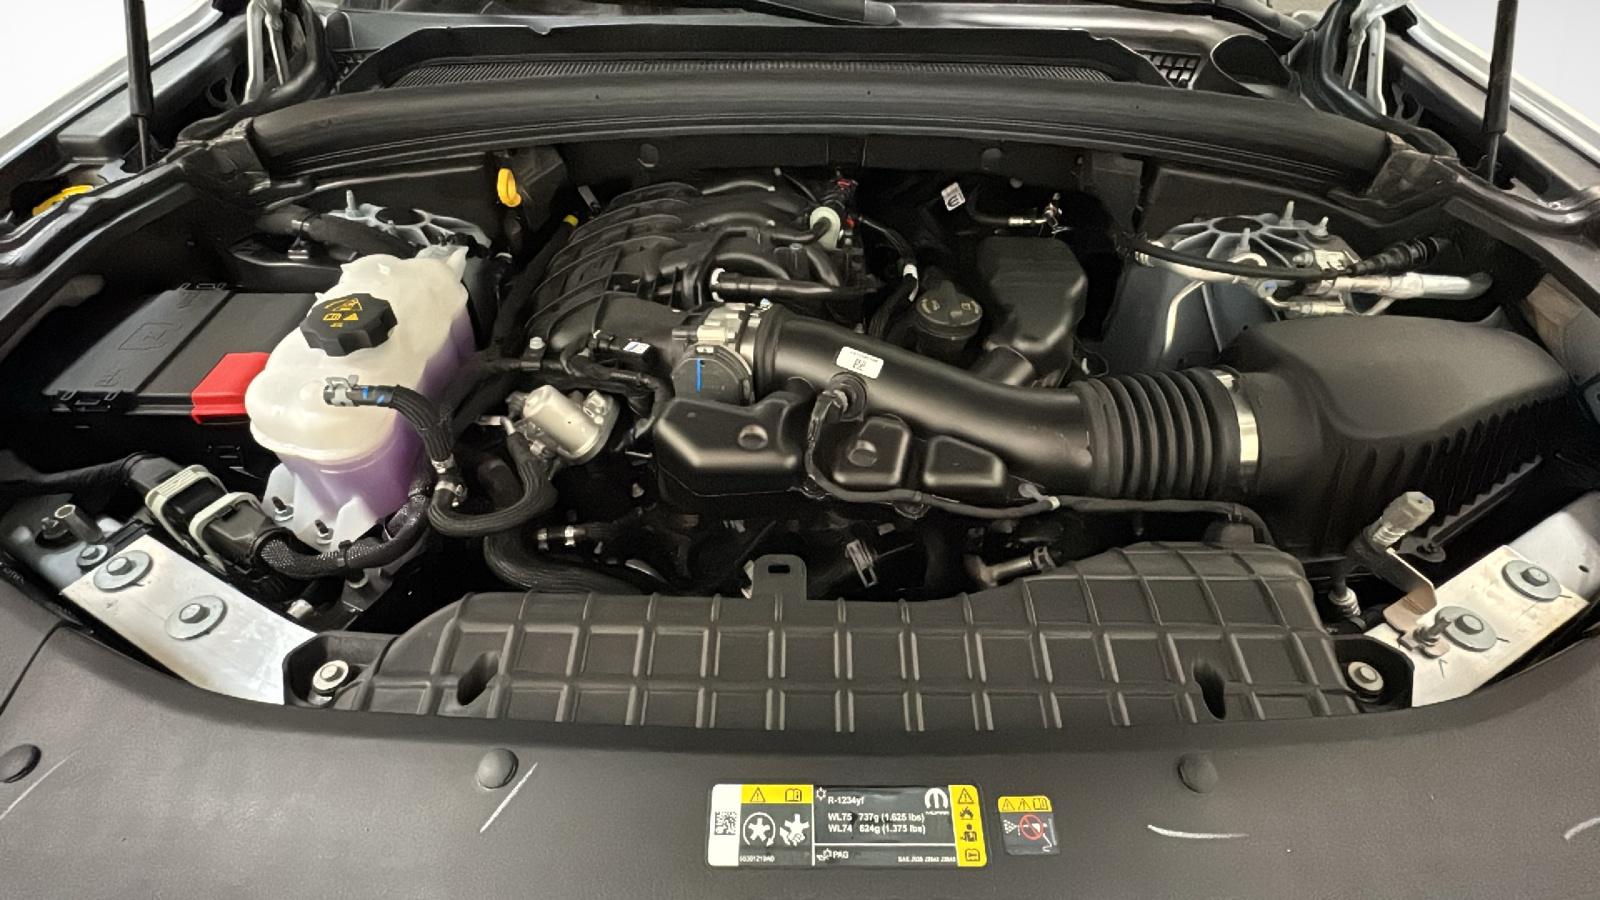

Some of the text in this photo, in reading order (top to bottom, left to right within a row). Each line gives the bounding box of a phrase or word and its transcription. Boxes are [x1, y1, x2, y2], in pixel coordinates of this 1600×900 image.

[828, 796, 865, 807] R-1234yf
[827, 812, 925, 823] WL75 737g (1.625 lbs)
[828, 824, 926, 835] WL74 624g (1.375 lbs)
[832, 850, 849, 859] PAG
